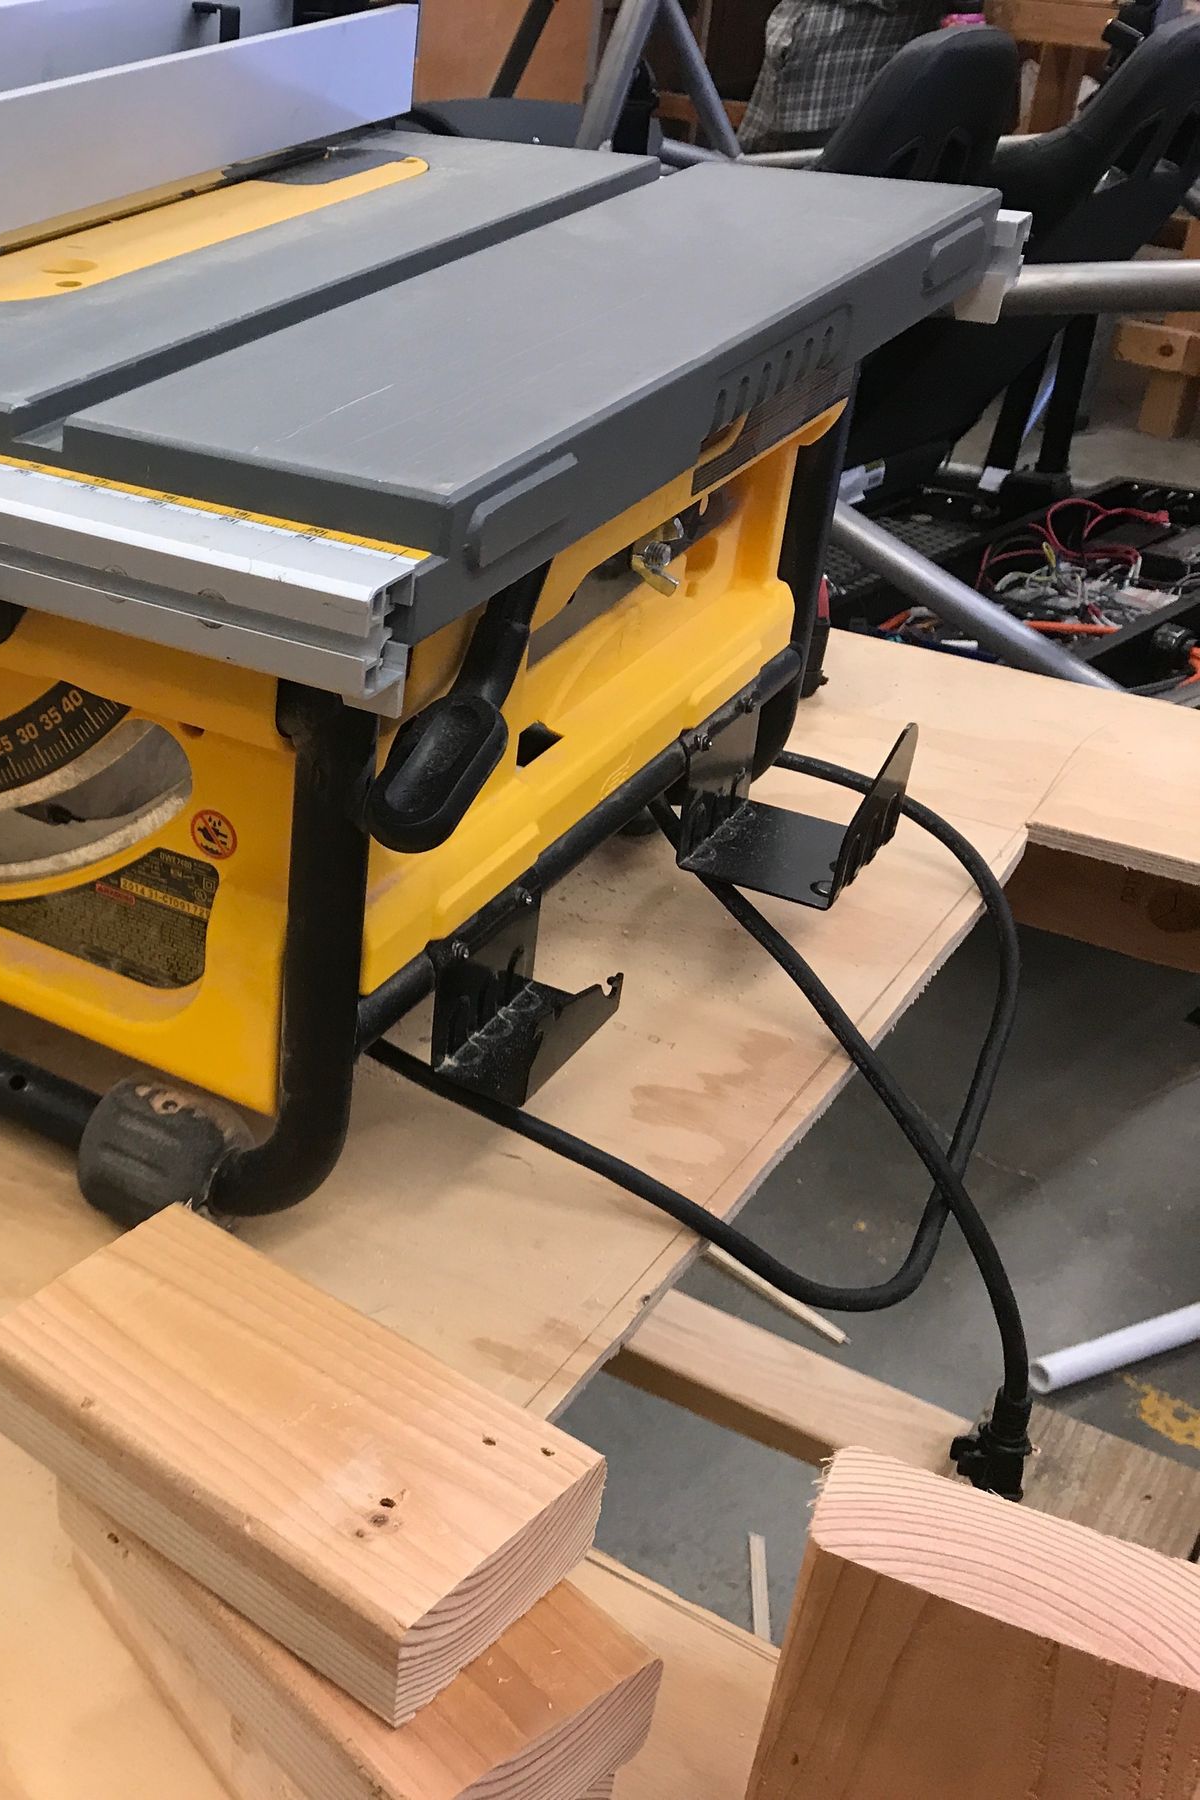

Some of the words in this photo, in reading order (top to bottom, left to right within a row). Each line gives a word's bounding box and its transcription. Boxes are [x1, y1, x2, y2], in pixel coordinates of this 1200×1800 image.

[16, 722, 39, 744] 30
[39, 706, 63, 731] 35
[61, 689, 84, 713] 40
